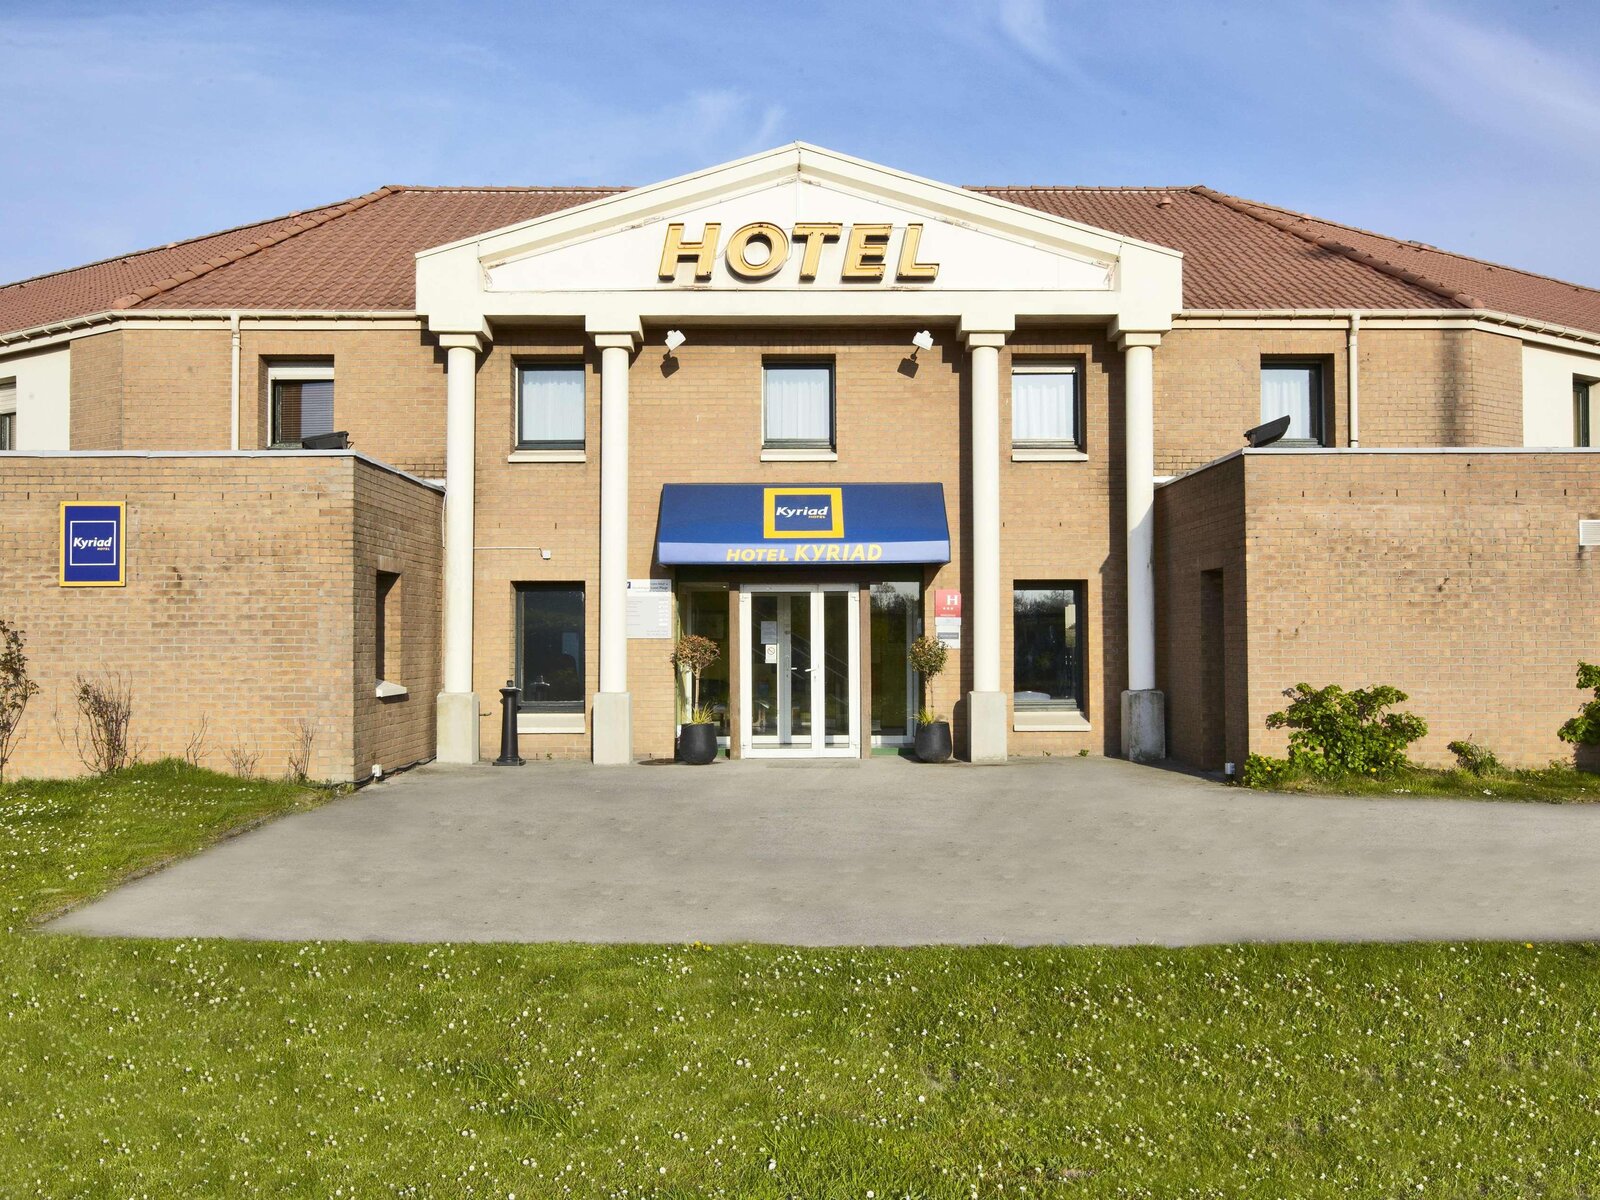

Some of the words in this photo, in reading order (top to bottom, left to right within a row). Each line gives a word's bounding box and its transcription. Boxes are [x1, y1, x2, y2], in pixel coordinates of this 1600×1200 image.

[658, 222, 940, 281] HOTEL
[776, 506, 828, 518] Kyriad
[73, 537, 112, 549] Kyriad
[726, 549, 789, 562] HOTEL
[794, 543, 883, 562] KYRIAD
[946, 594, 958, 606] H
